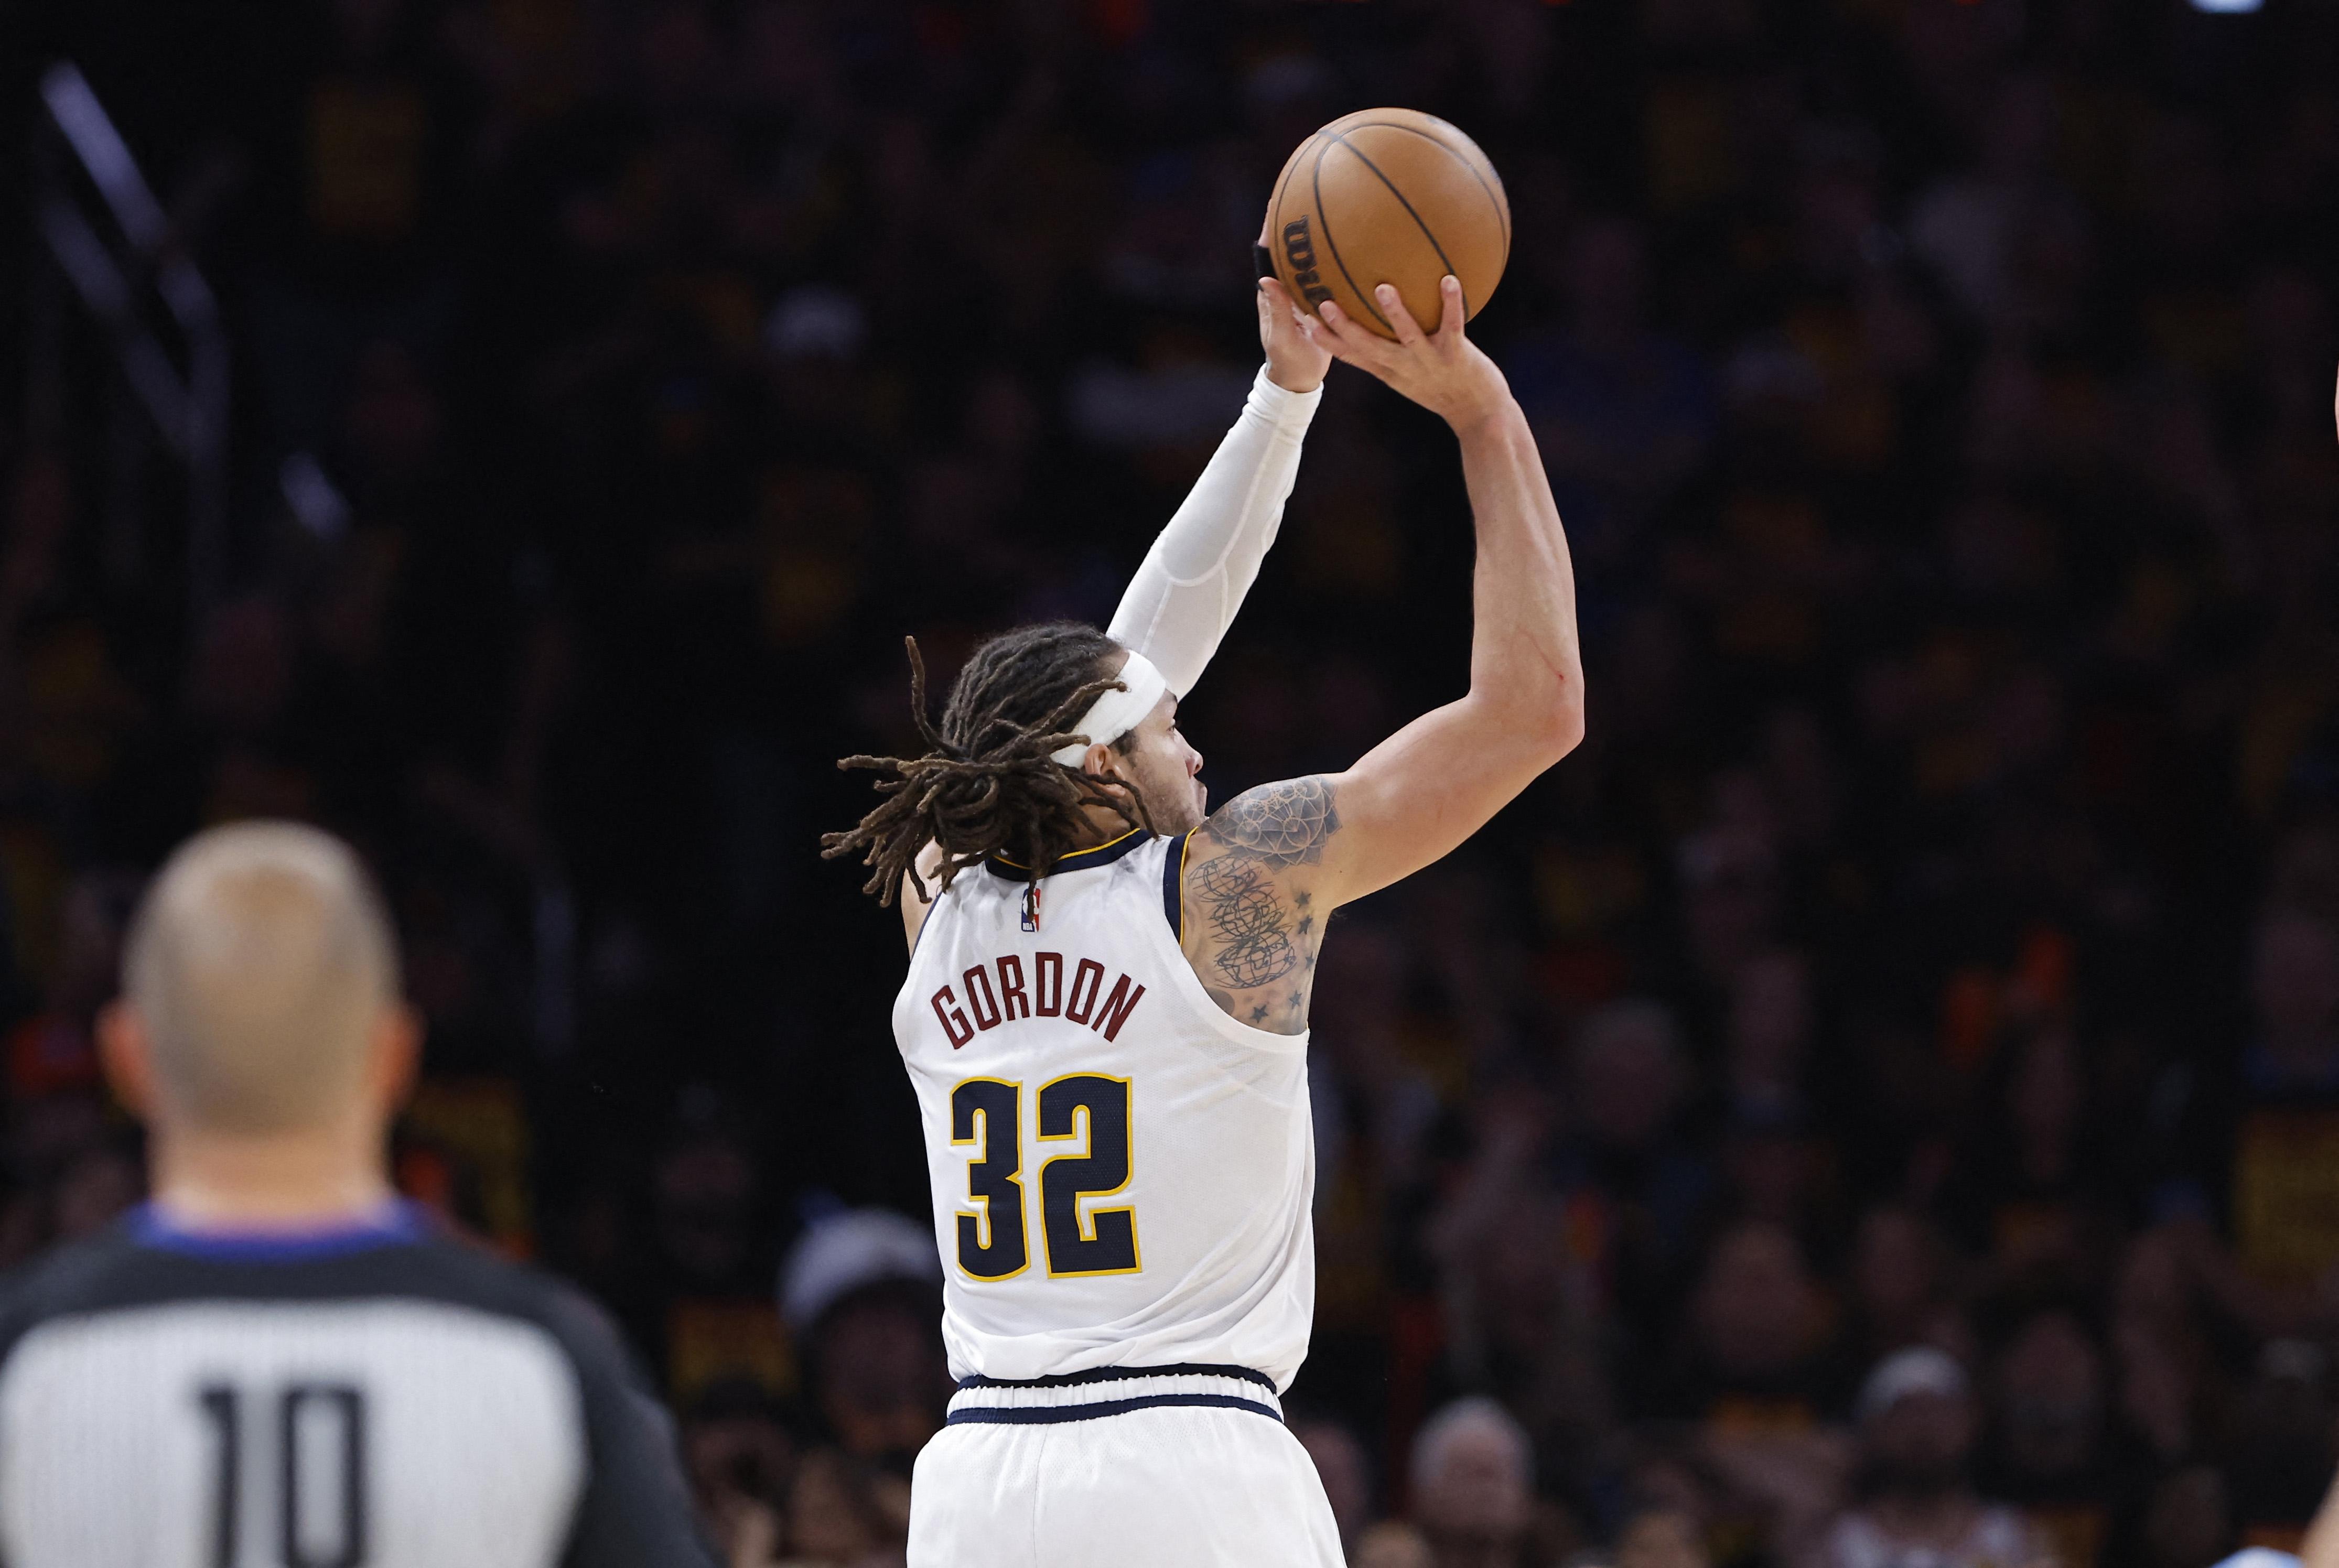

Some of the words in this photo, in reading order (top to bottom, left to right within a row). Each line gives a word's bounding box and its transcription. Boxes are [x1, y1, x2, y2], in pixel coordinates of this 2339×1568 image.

[1022, 922, 1033, 931] NBA
[931, 951, 1146, 1050] GORDON
[949, 1071, 1143, 1282] 32
[192, 1378, 370, 1568] 10
